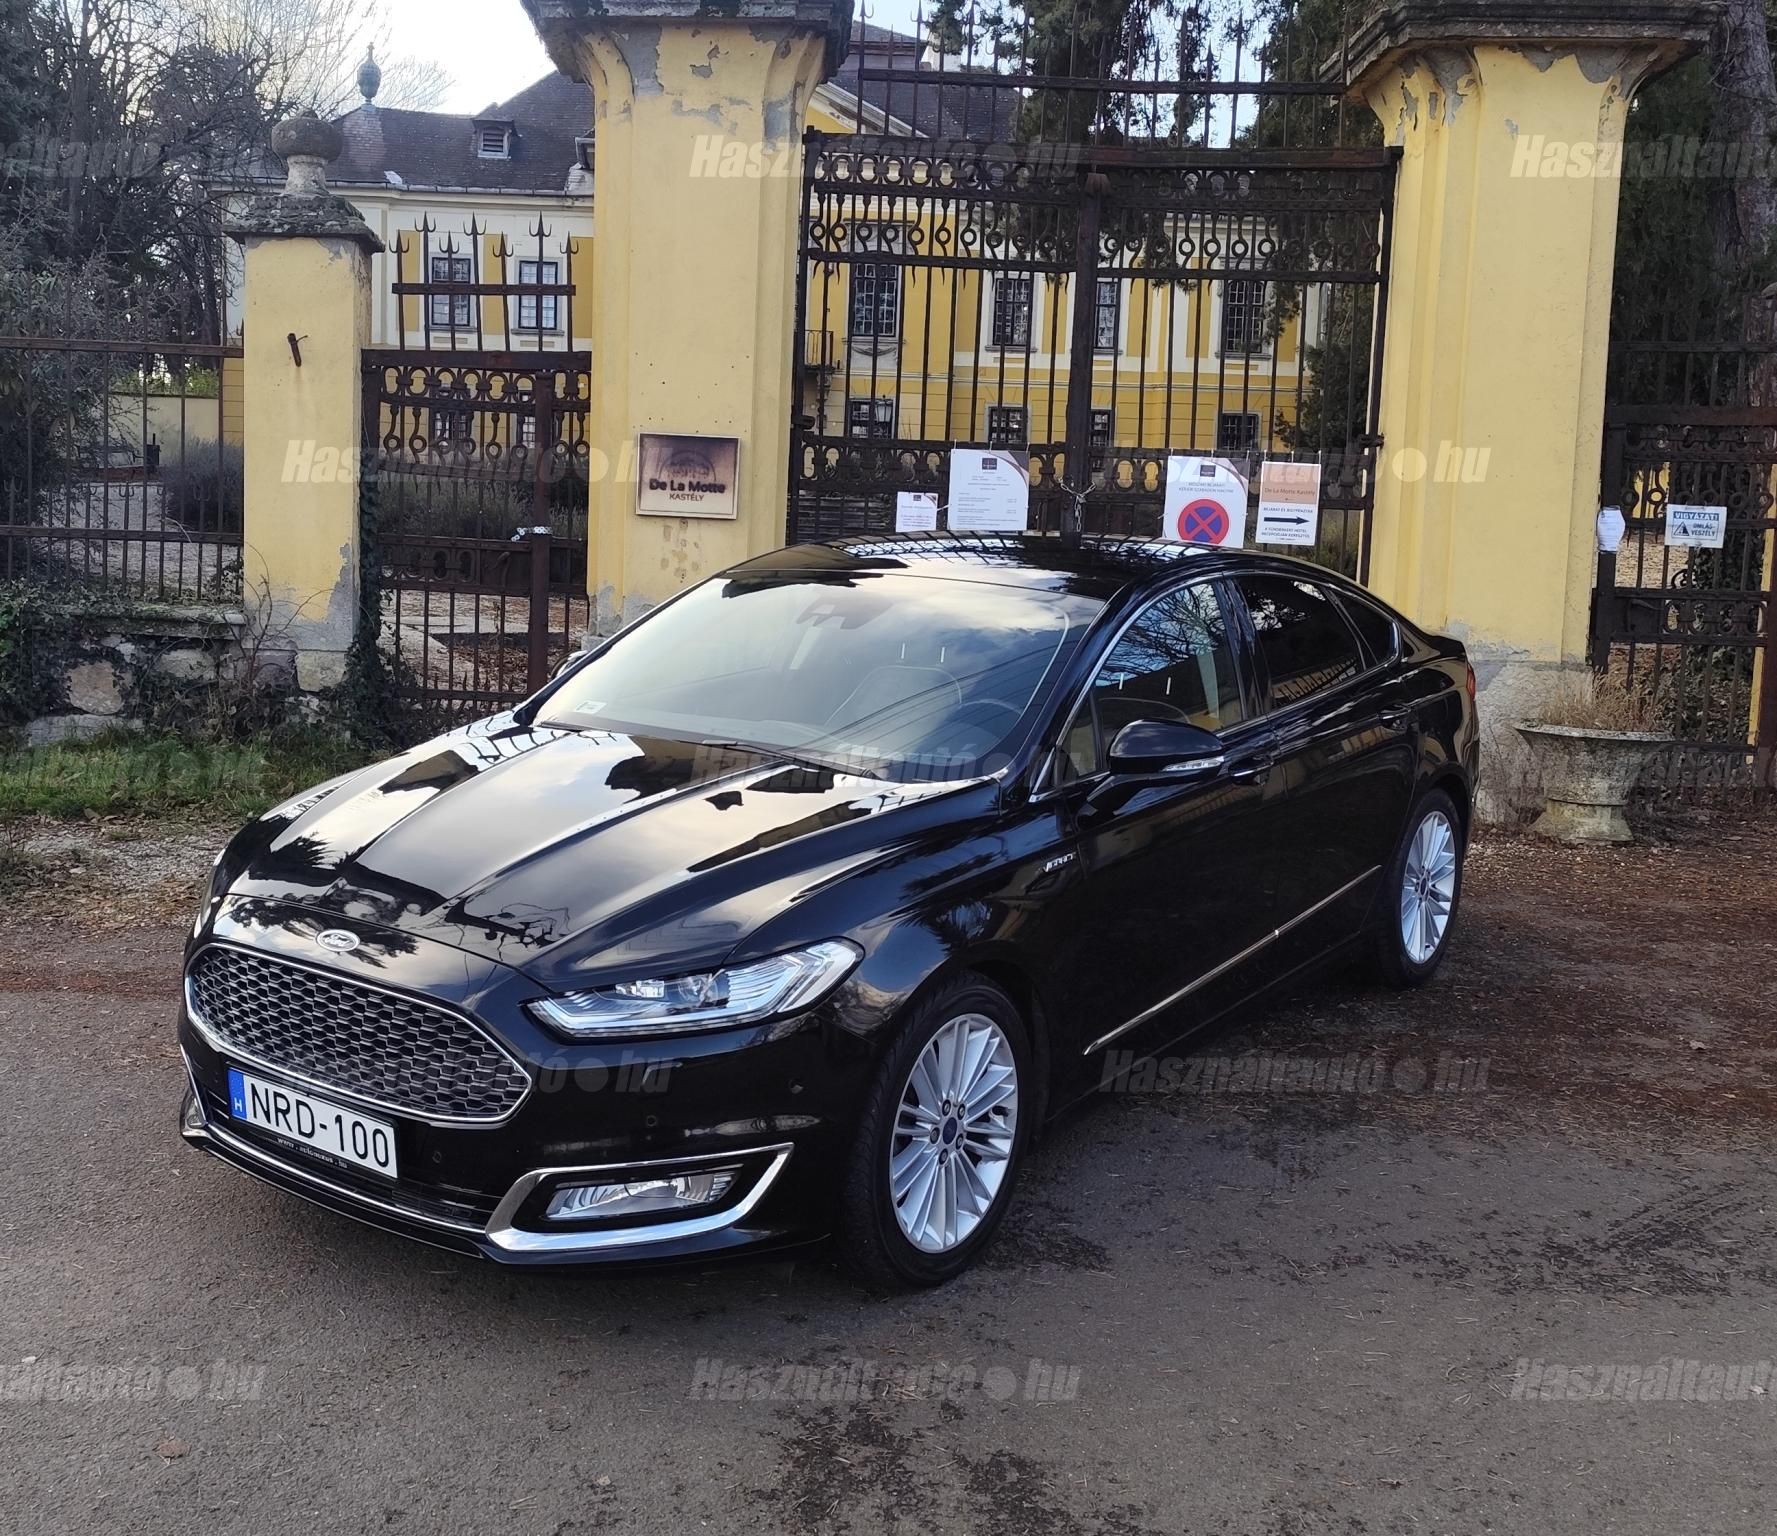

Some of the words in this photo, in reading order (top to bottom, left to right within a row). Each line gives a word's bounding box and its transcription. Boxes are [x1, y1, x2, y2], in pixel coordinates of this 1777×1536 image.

[649, 478, 667, 491] De
[669, 480, 686, 492] La
[688, 480, 726, 494] Motte
[669, 492, 705, 502] KASTÉLY
[234, 1098, 243, 1113] H
[250, 1082, 390, 1168] NRD-100
